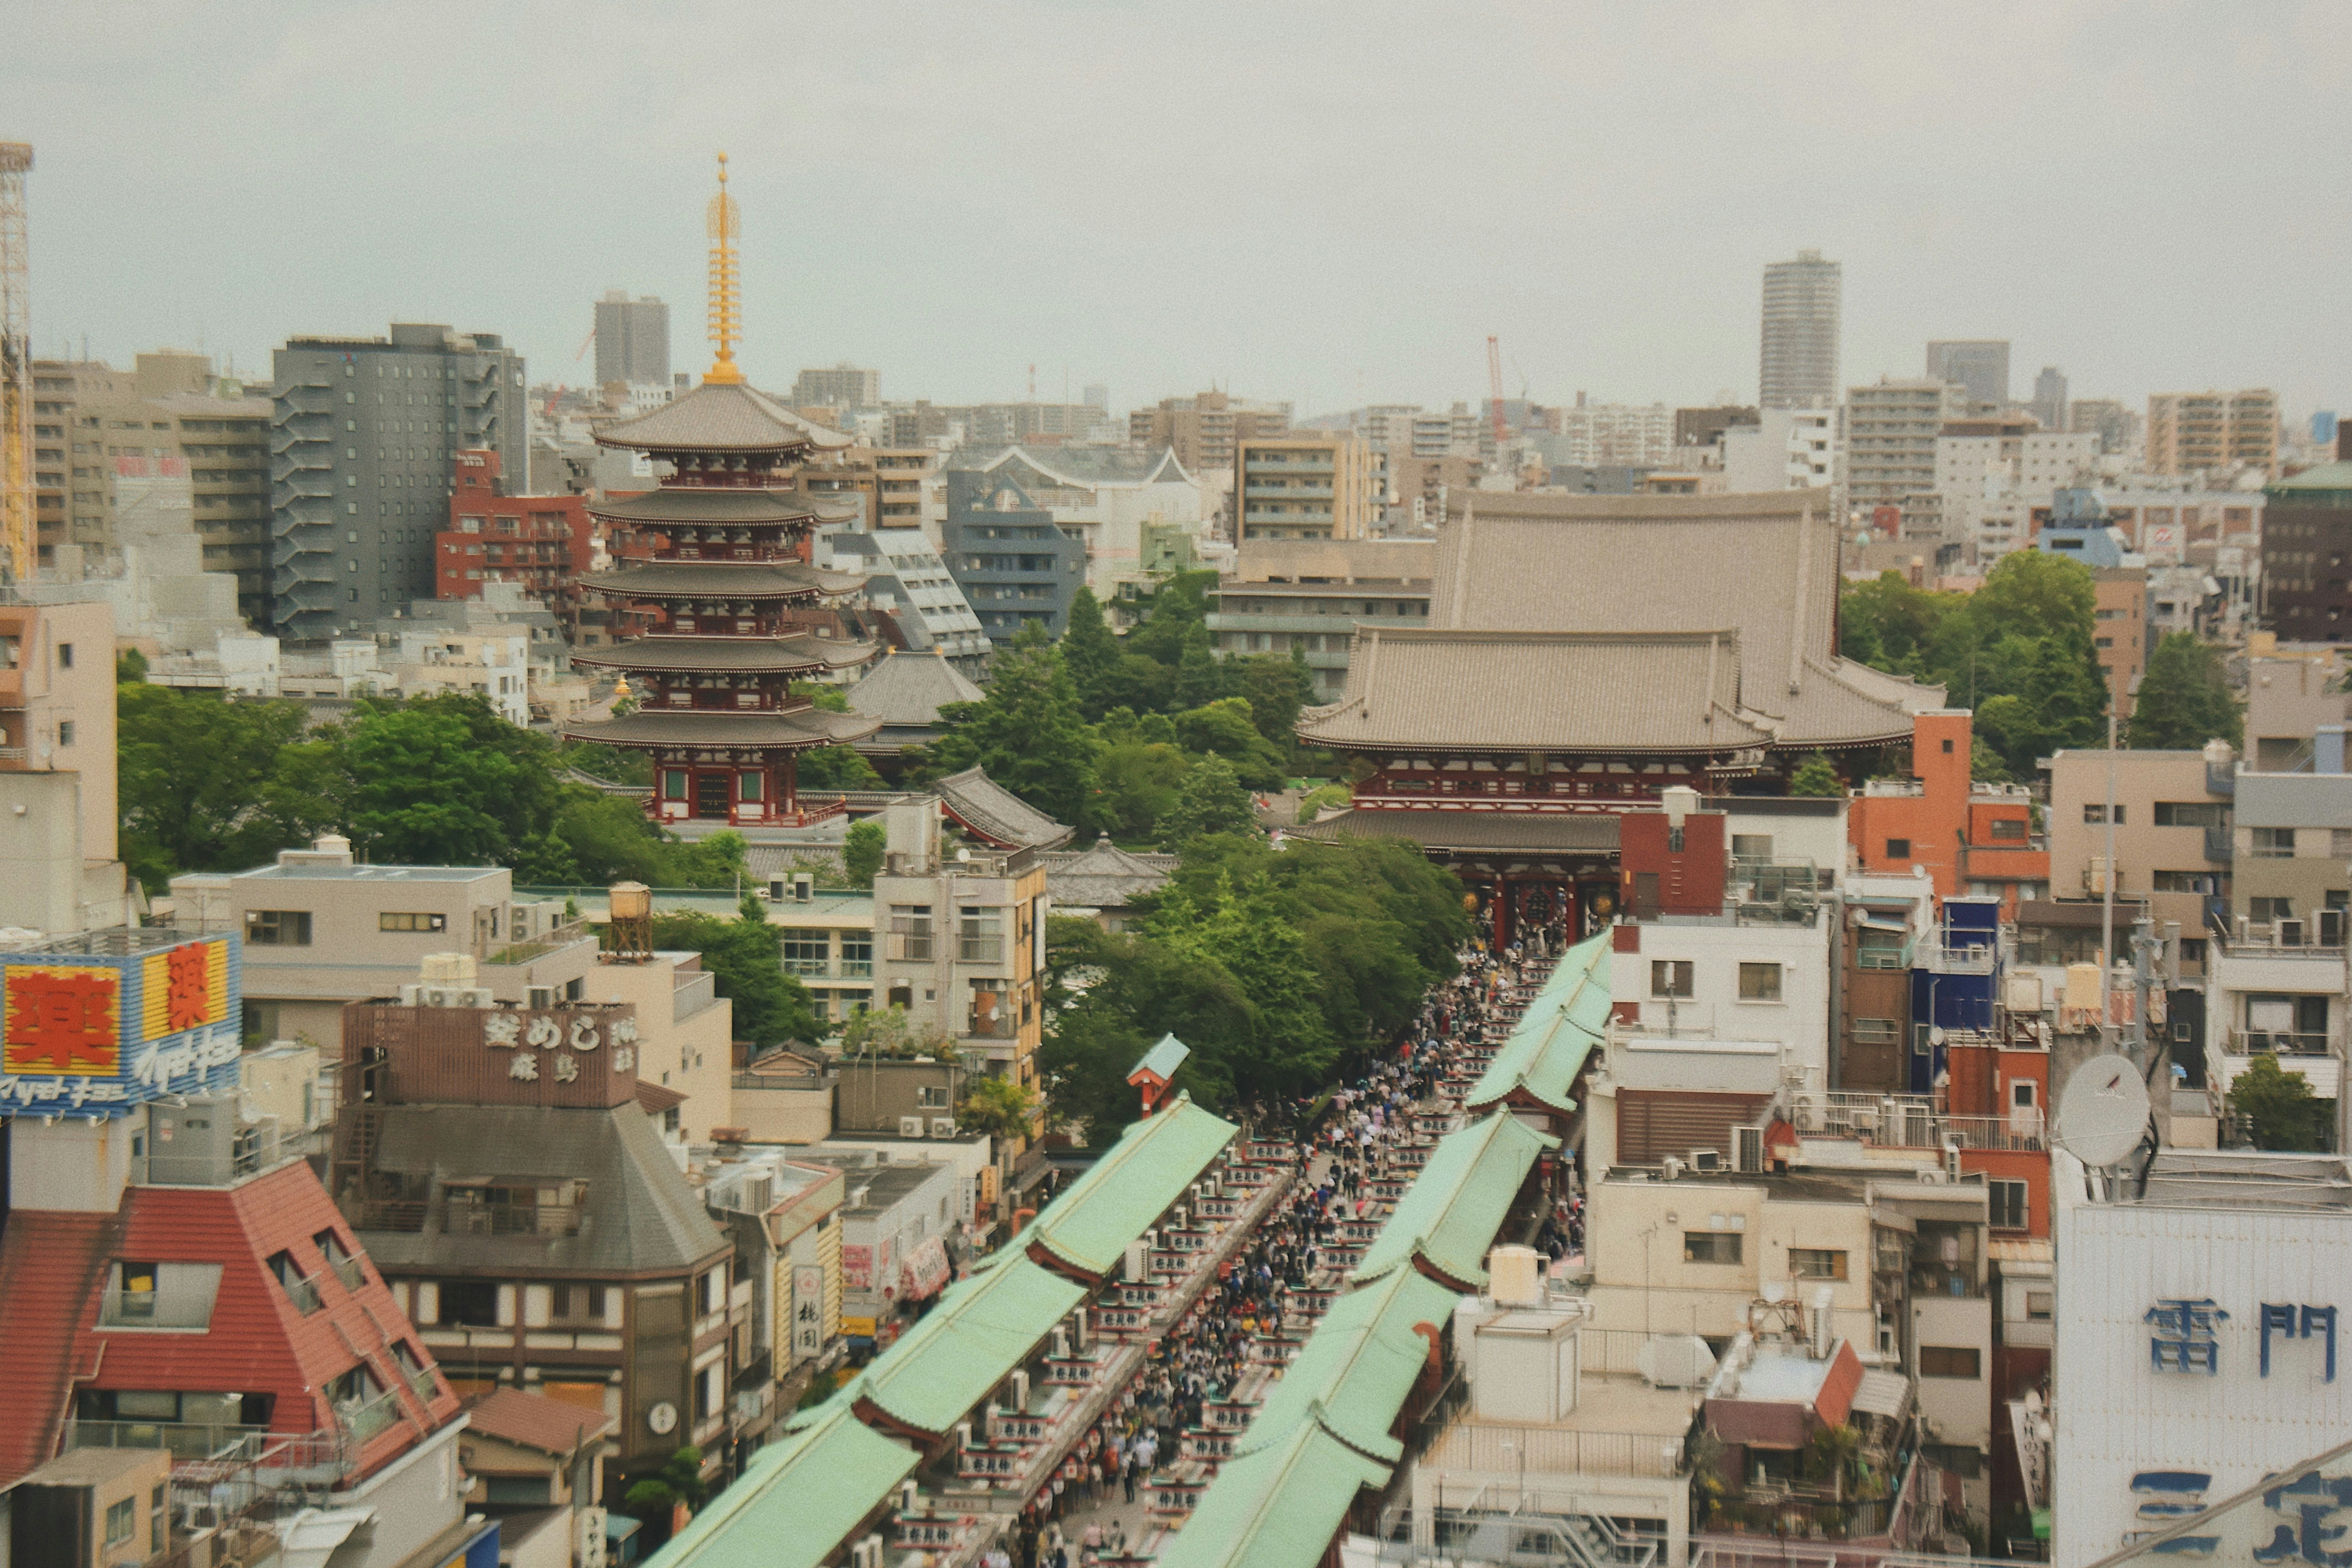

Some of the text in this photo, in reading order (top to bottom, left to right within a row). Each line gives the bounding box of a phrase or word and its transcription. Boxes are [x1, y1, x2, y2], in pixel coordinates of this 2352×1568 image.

[7, 971, 116, 1067] 薬
[168, 942, 209, 1030] 薬
[485, 1012, 600, 1051] 釜めし
[2143, 1298, 2337, 1383] 雷門
